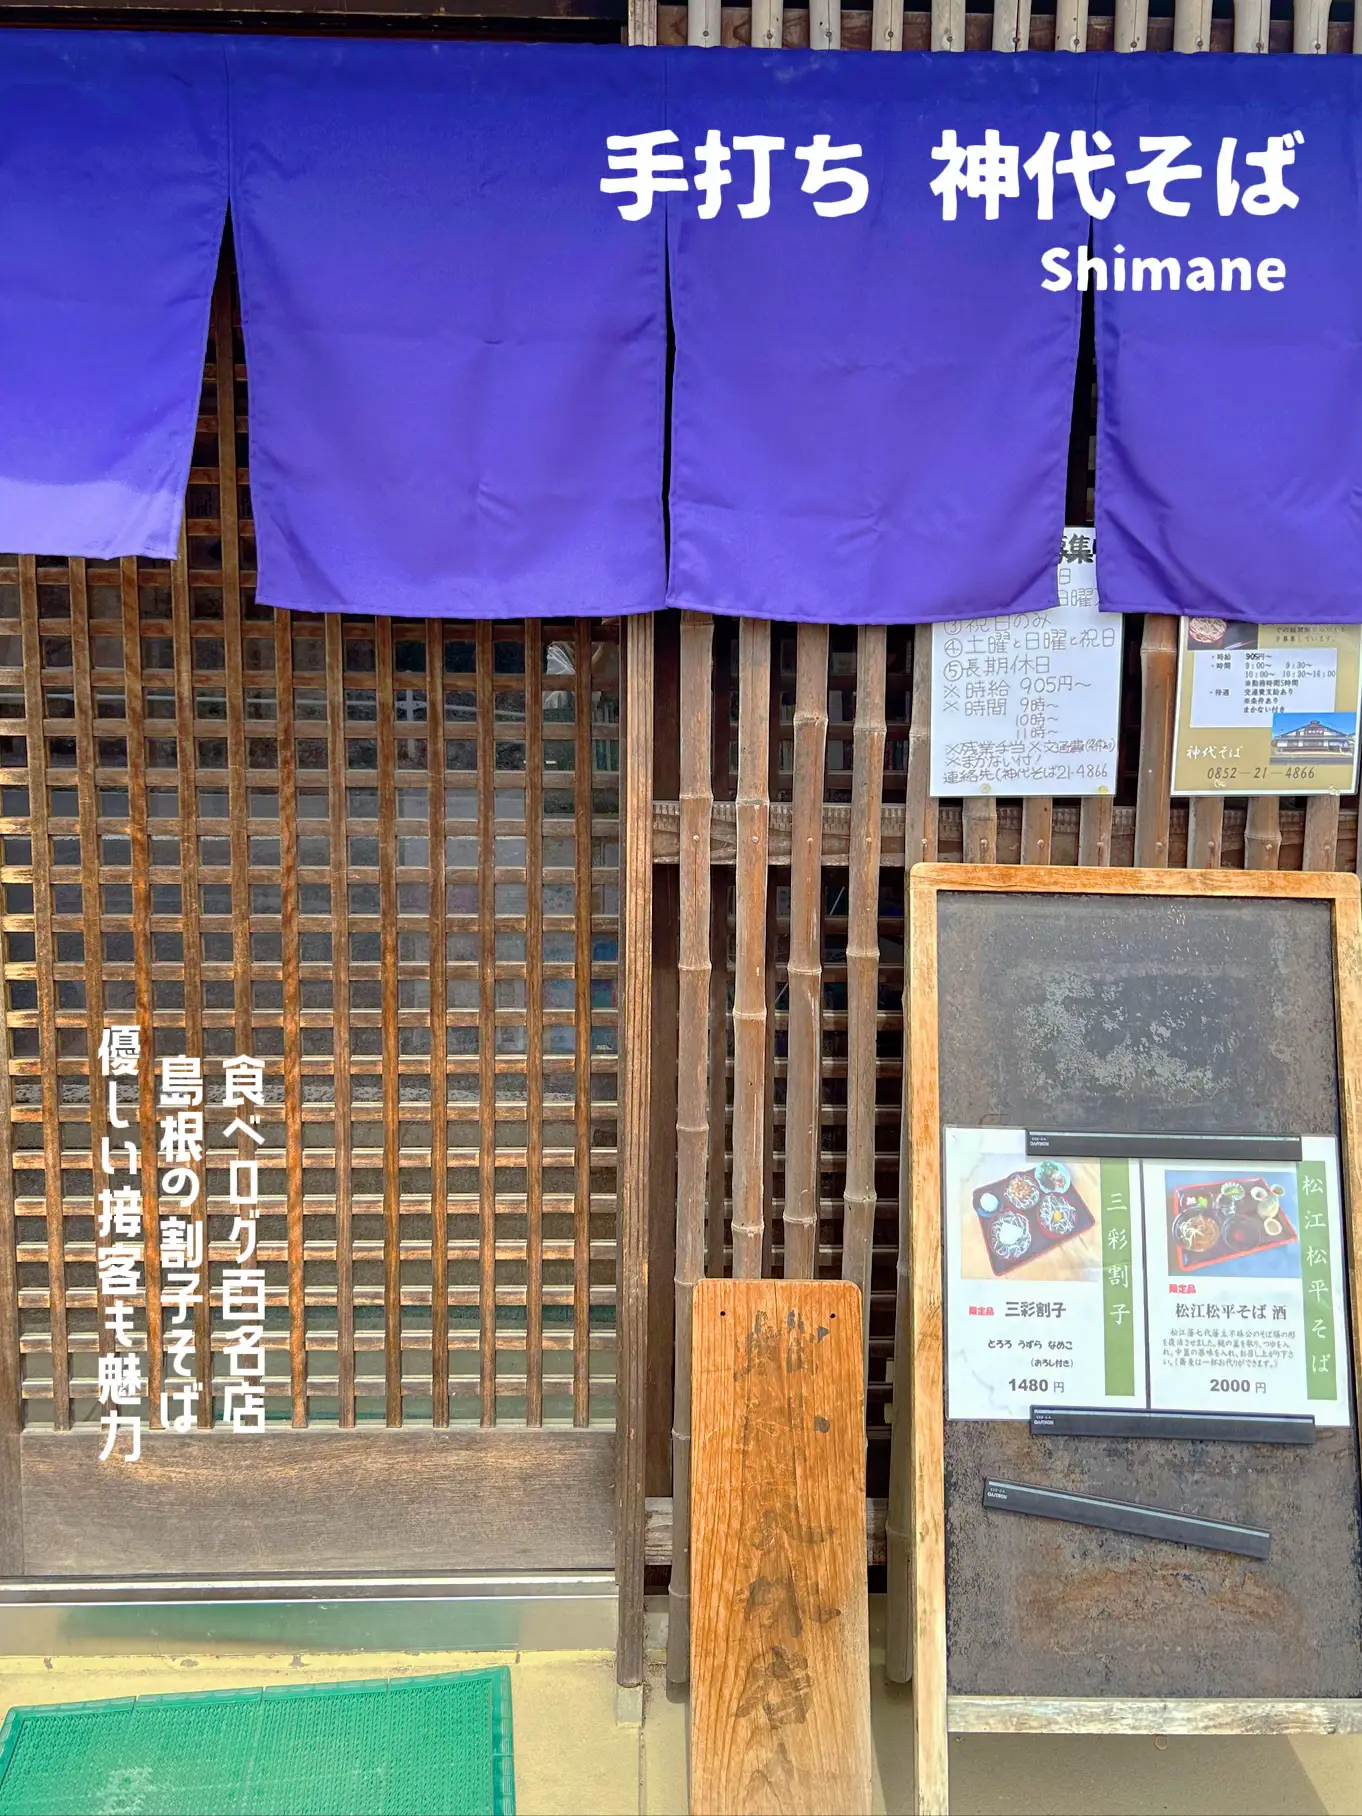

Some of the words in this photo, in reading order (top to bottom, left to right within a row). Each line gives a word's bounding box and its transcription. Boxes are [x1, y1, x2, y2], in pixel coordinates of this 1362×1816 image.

[1186, 745, 1244, 760] 神代そば
[1106, 1192, 1131, 1325] 三彩割子
[1302, 1175, 1332, 1373] 松江松平そば
[1005, 1301, 1067, 1318] 三彩割子
[1175, 1303, 1267, 1319] 松江松平そば
[988, 1339, 1013, 1349] とろろ
[1018, 1339, 1043, 1350] うずら
[1048, 1340, 1074, 1350] なめこ
[1008, 1378, 1049, 1393] 1480
[1053, 1381, 1065, 1393] 円
[1209, 1379, 1251, 1393] 2000
[1255, 1382, 1267, 1394] 円
